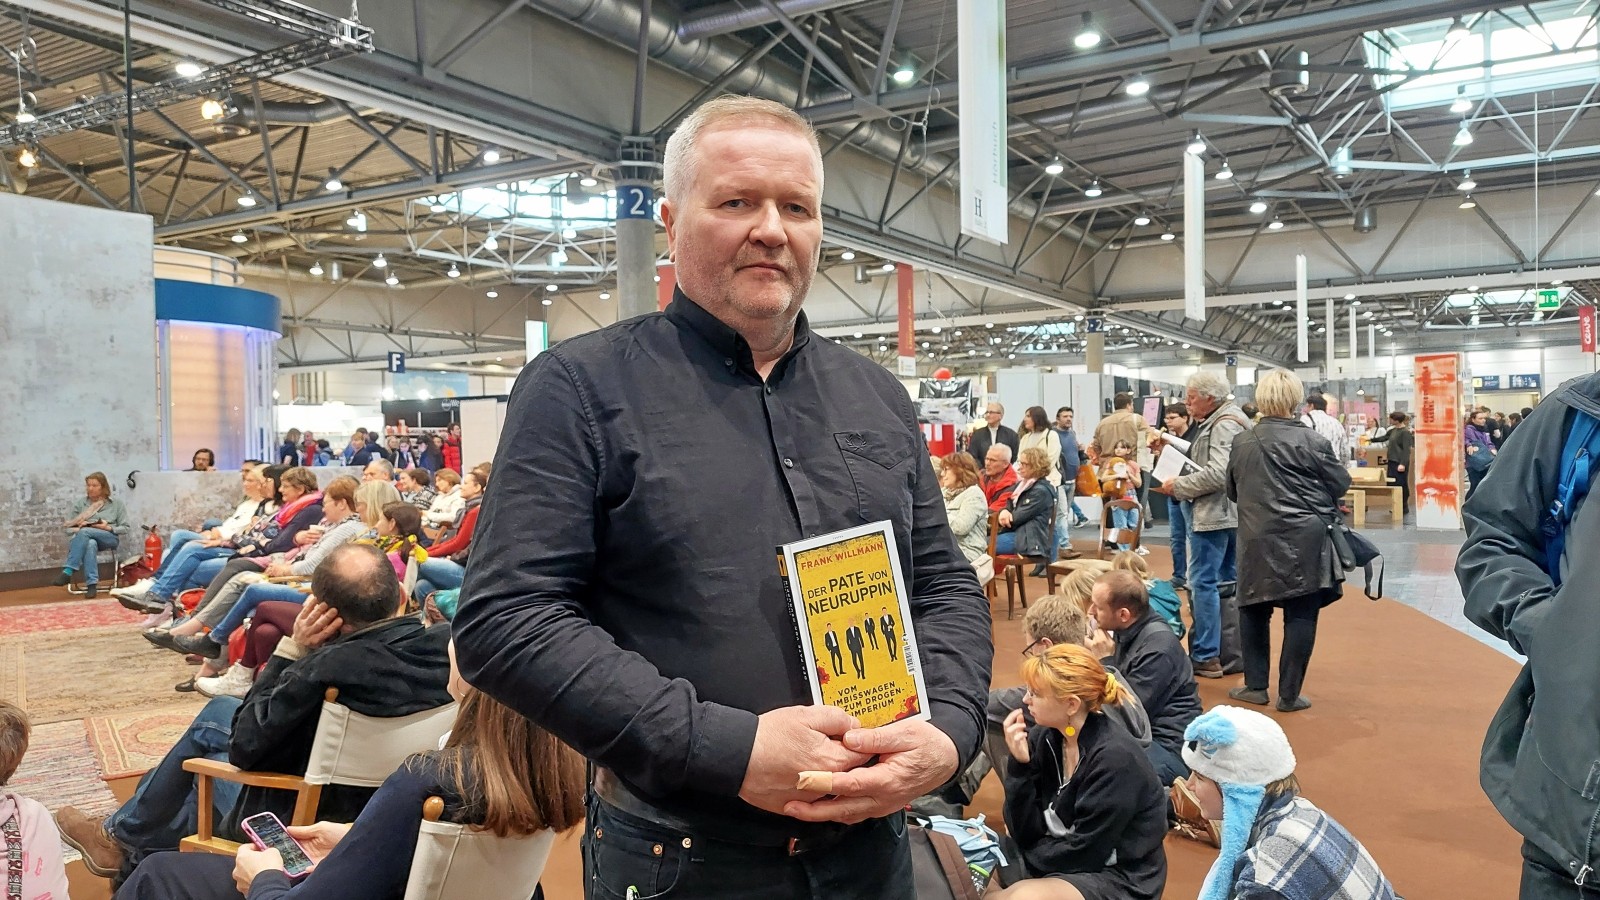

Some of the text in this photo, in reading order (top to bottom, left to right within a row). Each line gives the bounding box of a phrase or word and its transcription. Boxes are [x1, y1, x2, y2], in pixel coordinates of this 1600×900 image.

[630, 188, 645, 215] 2
[974, 197, 983, 218] H
[1095, 319, 1103, 332] 2
[1583, 315, 1592, 345] cewe
[392, 353, 401, 371] F
[800, 541, 884, 571] FRANK WILLMANN
[807, 569, 888, 599] DER PATE VON
[808, 580, 893, 616] NEURUPPIN
[833, 681, 896, 707] IMBISSWAGEN
[838, 685, 858, 696] VOM
[843, 687, 905, 712] ZUM DROGEN-
[851, 698, 895, 717] IMPERIUM
